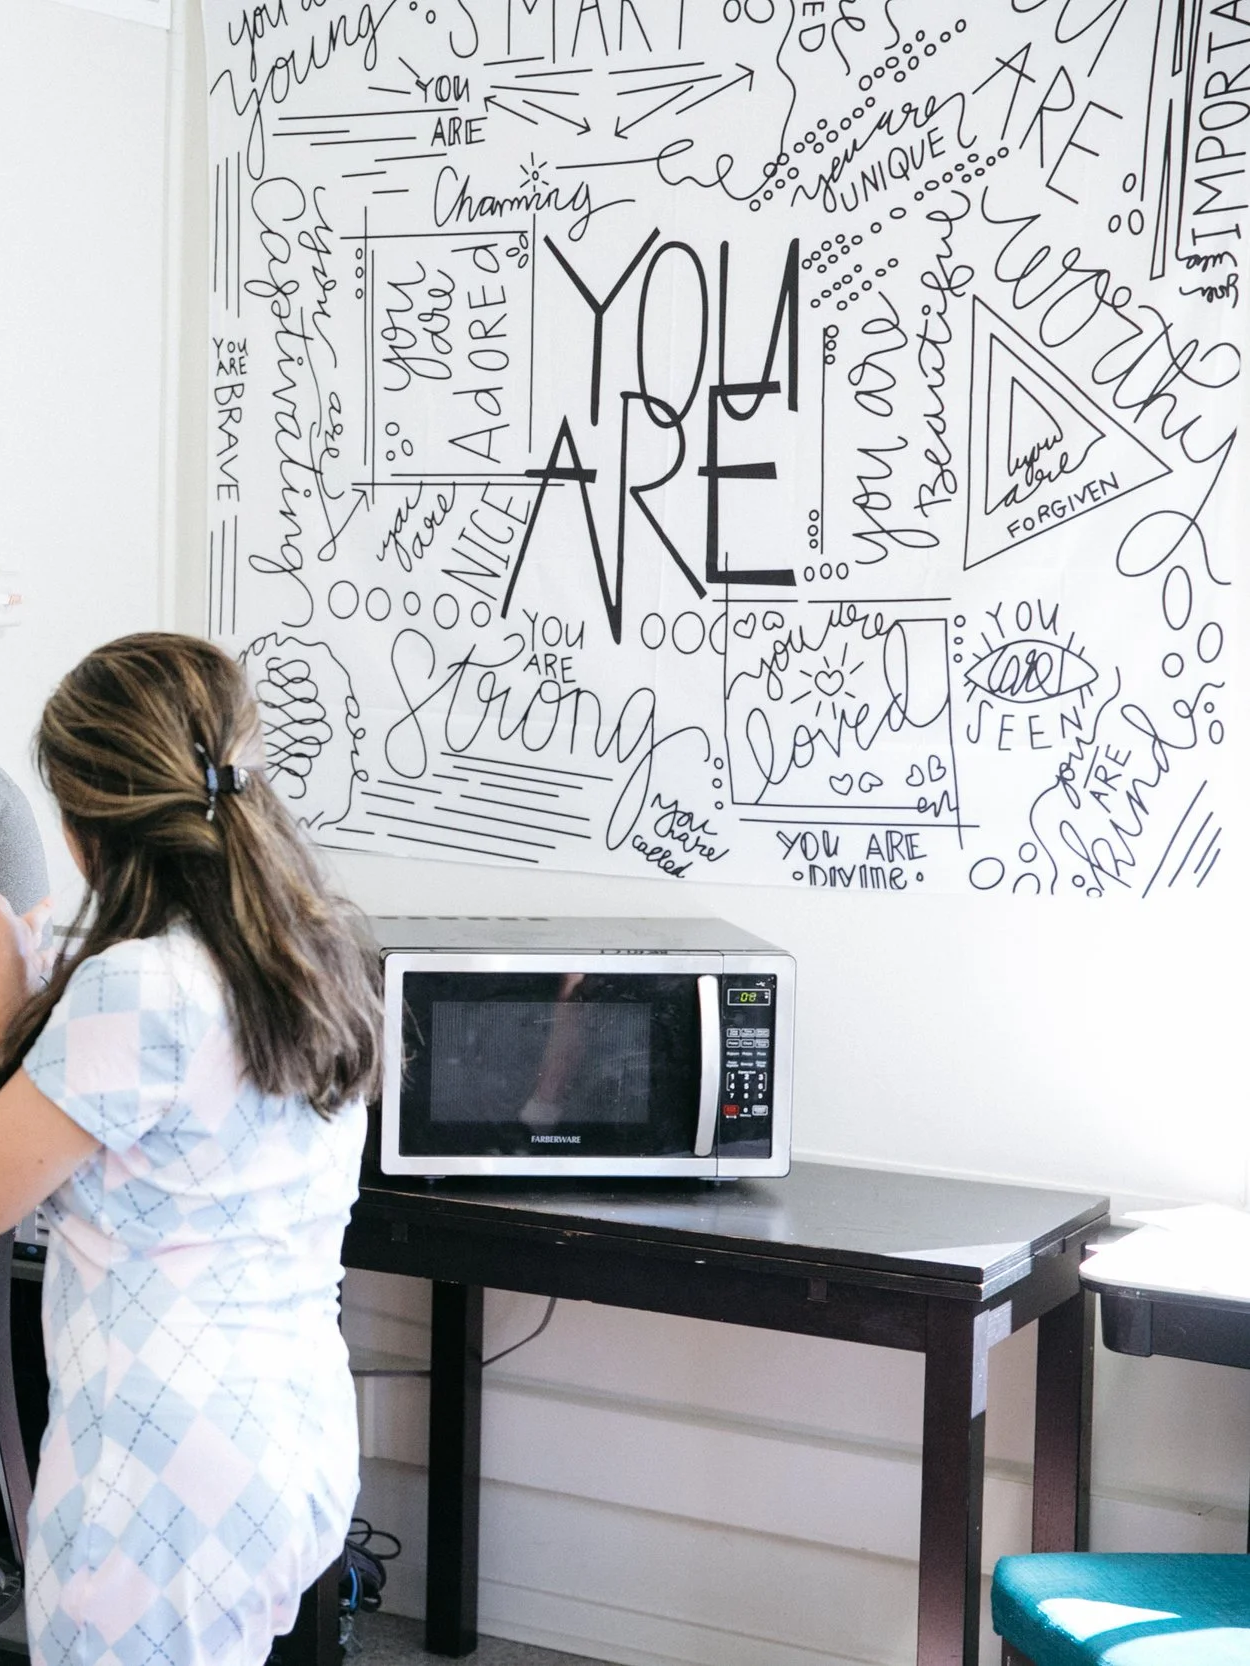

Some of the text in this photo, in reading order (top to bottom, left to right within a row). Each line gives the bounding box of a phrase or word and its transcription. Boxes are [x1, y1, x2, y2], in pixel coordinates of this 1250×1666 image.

[228, 0, 289, 82] you
[209, 3, 395, 181] young
[415, 75, 470, 104] YOU
[972, 42, 1124, 205] ARE
[431, 116, 488, 147] ARE
[791, 93, 972, 213] you are
[840, 126, 946, 212] UNIQUE
[434, 166, 634, 242] Charming
[212, 336, 248, 358] YOU
[298, 186, 345, 499] you are
[380, 260, 453, 391] you
[417, 269, 456, 355] are
[542, 226, 800, 428] YOU
[216, 357, 248, 377] ARE
[913, 189, 976, 518] Beautiful
[980, 185, 1241, 585] worthy
[244, 177, 323, 628] Captivating
[848, 291, 940, 565] you are
[213, 382, 245, 502] BRAVE
[1008, 434, 1063, 487] you
[410, 482, 456, 560] are
[441, 482, 531, 601] NICE
[500, 377, 798, 646] ARE
[1006, 471, 1120, 539] FORGIVEN
[522, 608, 585, 651] YOU
[985, 599, 1059, 638] YOU
[522, 652, 577, 684] ARE
[726, 625, 816, 701] you
[988, 645, 1064, 697] are
[384, 628, 710, 851] Strong
[746, 620, 949, 805] loved
[966, 699, 1083, 751] SEEN
[1056, 733, 1096, 809] you
[1059, 703, 1197, 891] kind
[1090, 744, 1132, 813] ARE
[650, 793, 718, 837] you
[775, 830, 928, 863] YOU ARE
[632, 834, 687, 878] called
[530, 1135, 582, 1144] FARBERWARE
